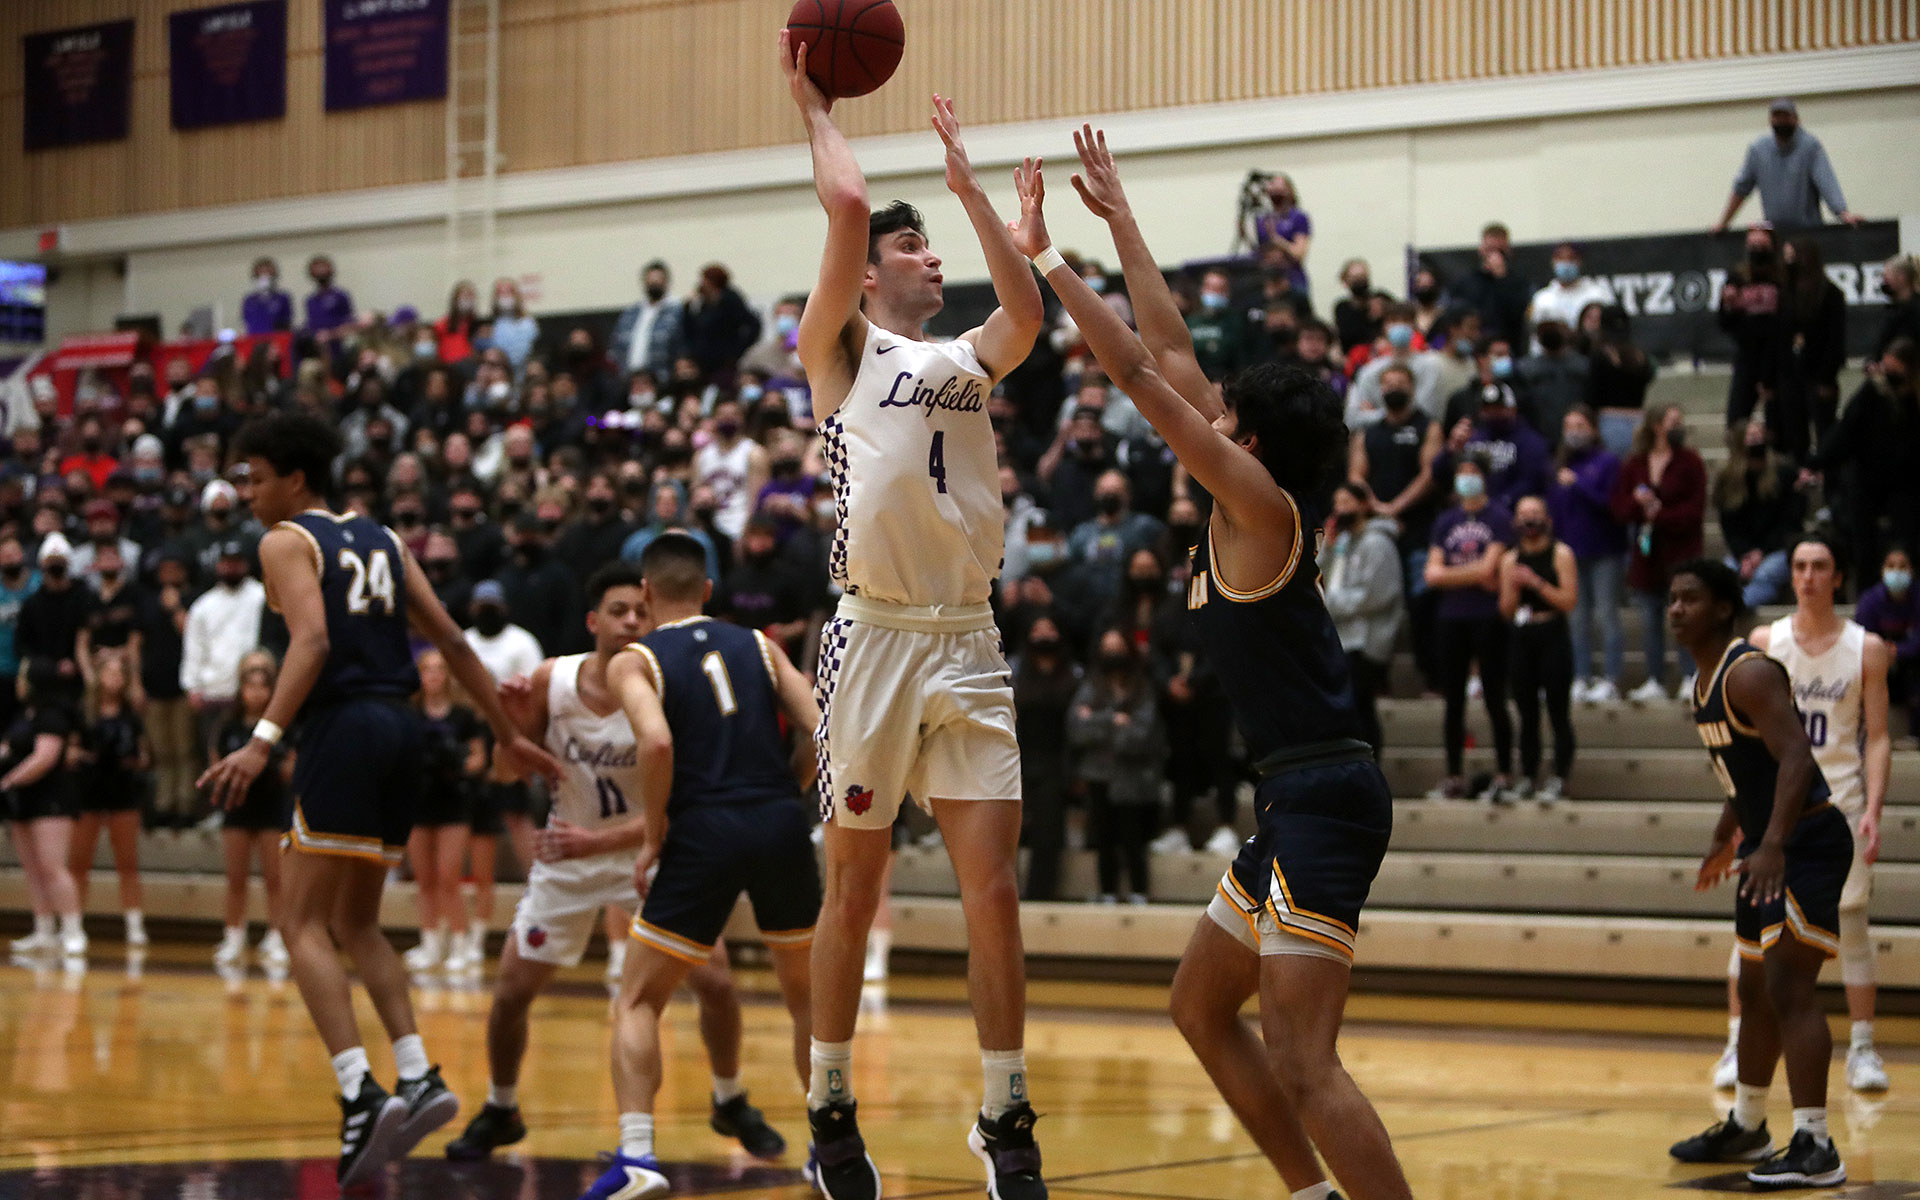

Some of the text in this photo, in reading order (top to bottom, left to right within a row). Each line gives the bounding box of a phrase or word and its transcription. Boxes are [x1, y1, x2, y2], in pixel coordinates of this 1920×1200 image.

[879, 371, 983, 418] Linfield
[928, 430, 948, 494] 4
[337, 548, 396, 615] 24
[701, 650, 738, 717] 1
[597, 777, 628, 818] 11
